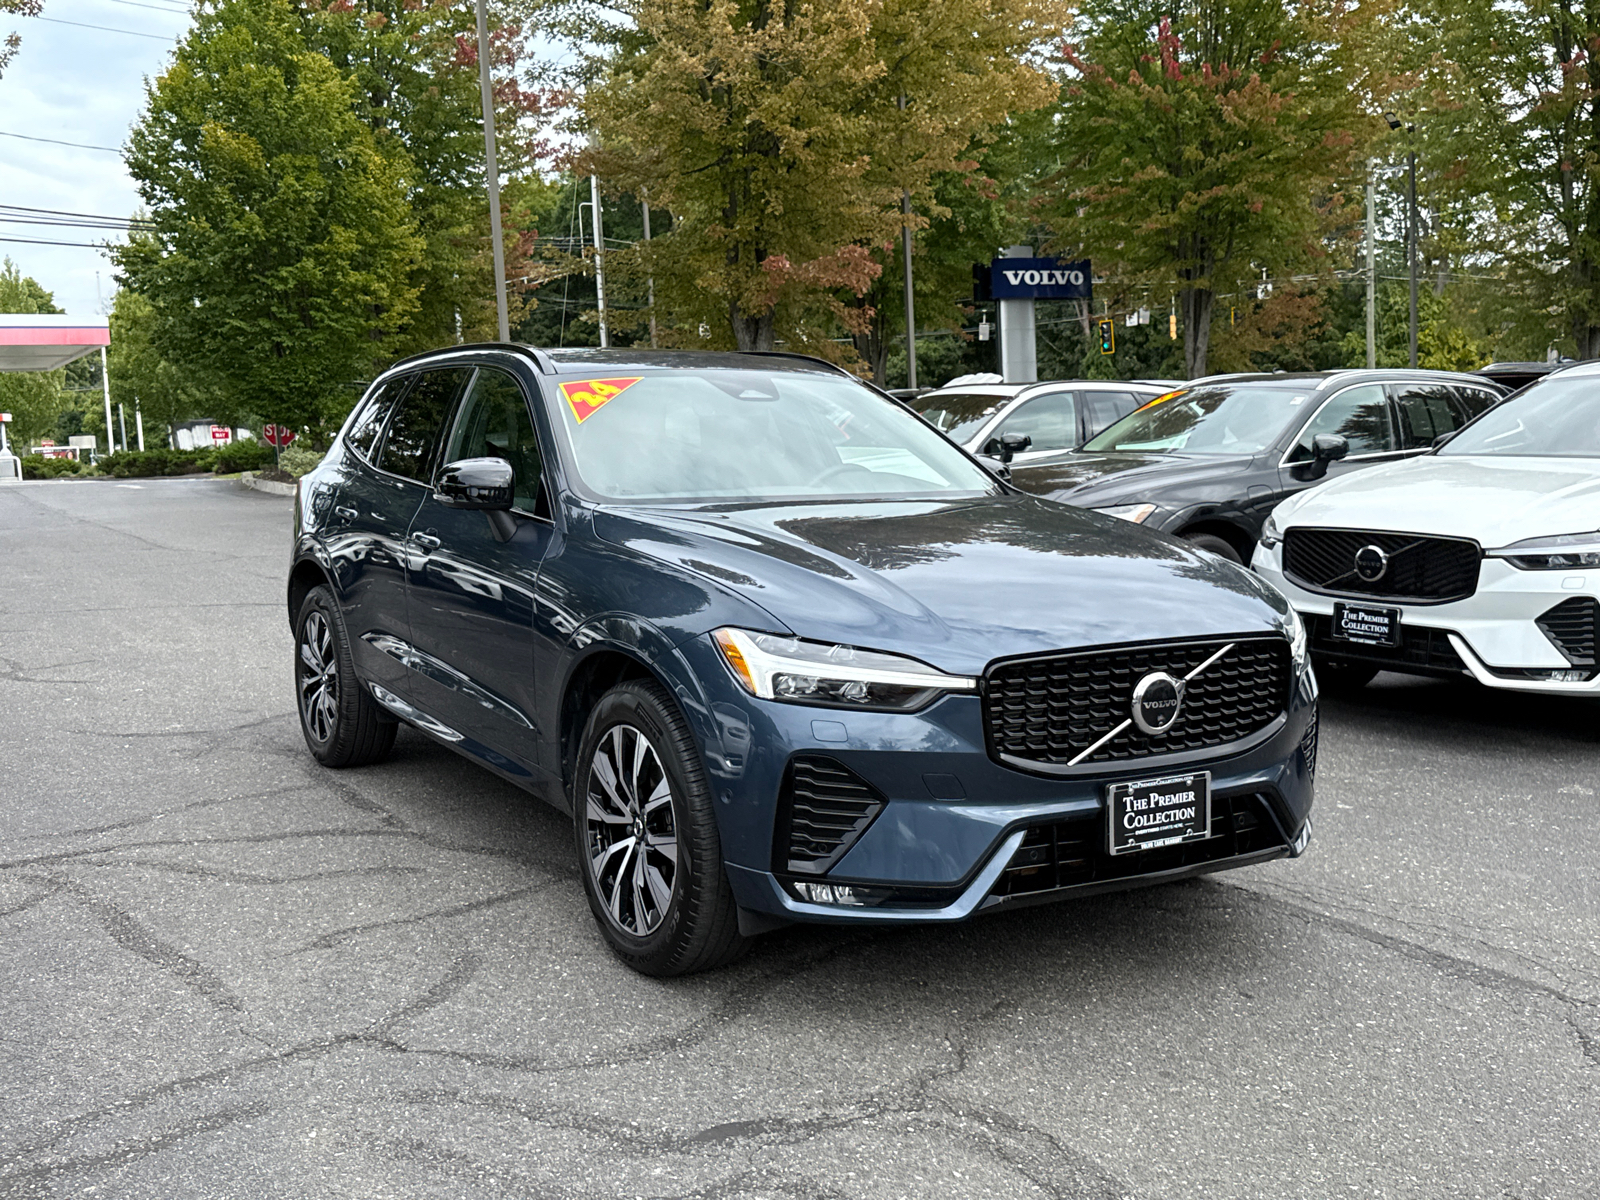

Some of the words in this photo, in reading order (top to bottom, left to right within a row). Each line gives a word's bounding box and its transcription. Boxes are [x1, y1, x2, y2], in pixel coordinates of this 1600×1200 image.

[1002, 269, 1084, 286] VOLVO
[570, 381, 621, 408] 24
[1342, 609, 1358, 621] THE
[1358, 611, 1389, 625] PREMIER
[1341, 618, 1389, 634] COLLECTION
[1143, 699, 1177, 709] VOLVO
[1123, 796, 1149, 812] THE
[1149, 791, 1195, 808] PREMIER
[1123, 807, 1195, 829] COLLECTION
